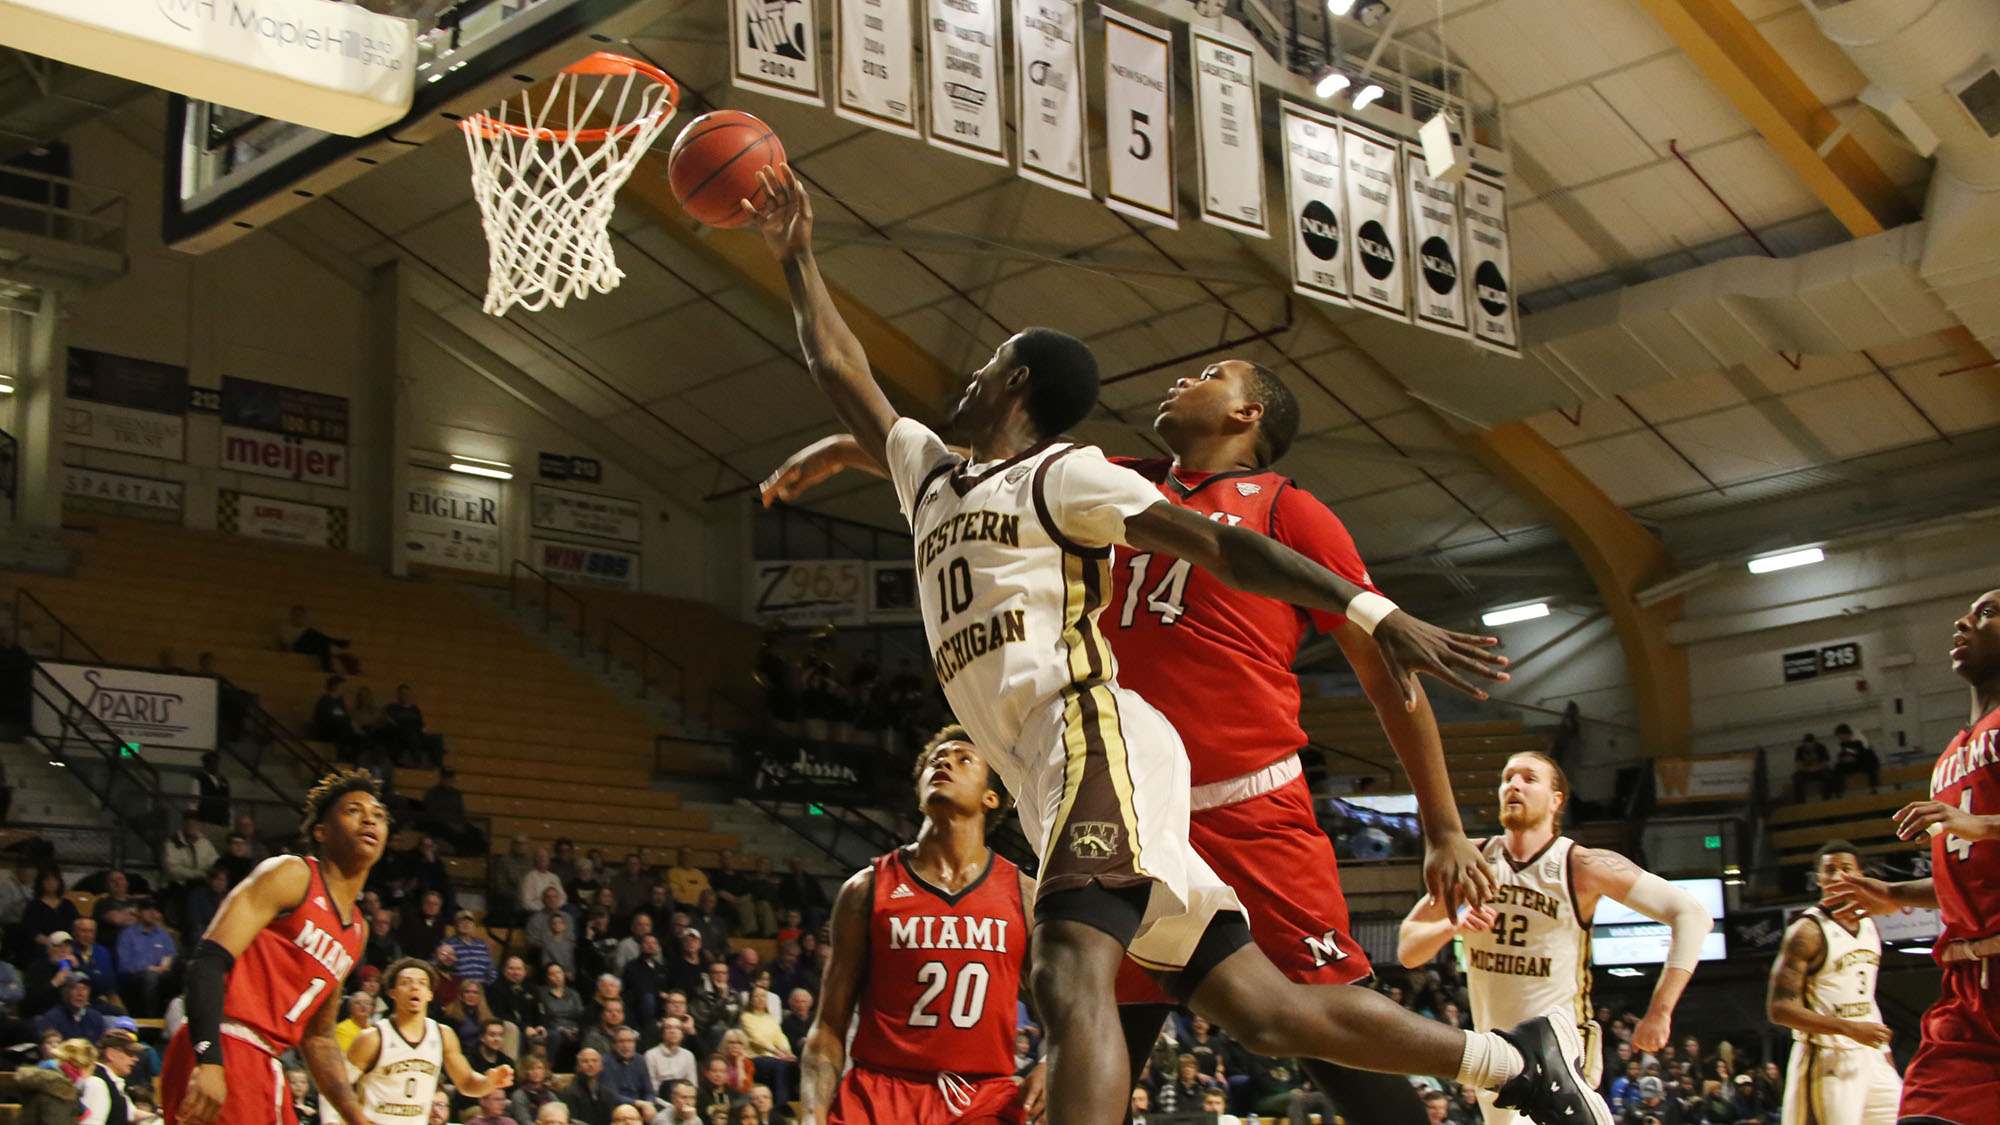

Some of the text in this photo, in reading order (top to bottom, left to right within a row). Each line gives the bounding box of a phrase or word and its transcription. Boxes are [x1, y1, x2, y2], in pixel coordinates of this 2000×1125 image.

[229, 2, 321, 50] Maple
[360, 50, 401, 72] group
[361, 36, 393, 54] auto
[760, 58, 795, 79] 2004
[1129, 109, 1152, 160] 5
[1302, 217, 1339, 241] NCAA
[227, 432, 342, 481] meijer
[66, 474, 178, 505] SPARTAN
[917, 510, 1020, 584] WESTERN
[937, 556, 973, 625] 10
[1119, 552, 1194, 630] 14
[933, 609, 1026, 689] MICHIGAN
[1824, 646, 1856, 669] 215
[1485, 883, 1560, 920] STERN
[888, 916, 1009, 953] MIAMI
[1301, 928, 1350, 968] M
[1492, 912, 1529, 947] 42
[1470, 947, 1552, 977] MICHIGAN
[284, 977, 328, 1024] 1
[907, 960, 990, 1029] 20
[404, 1078, 418, 1099] 0
